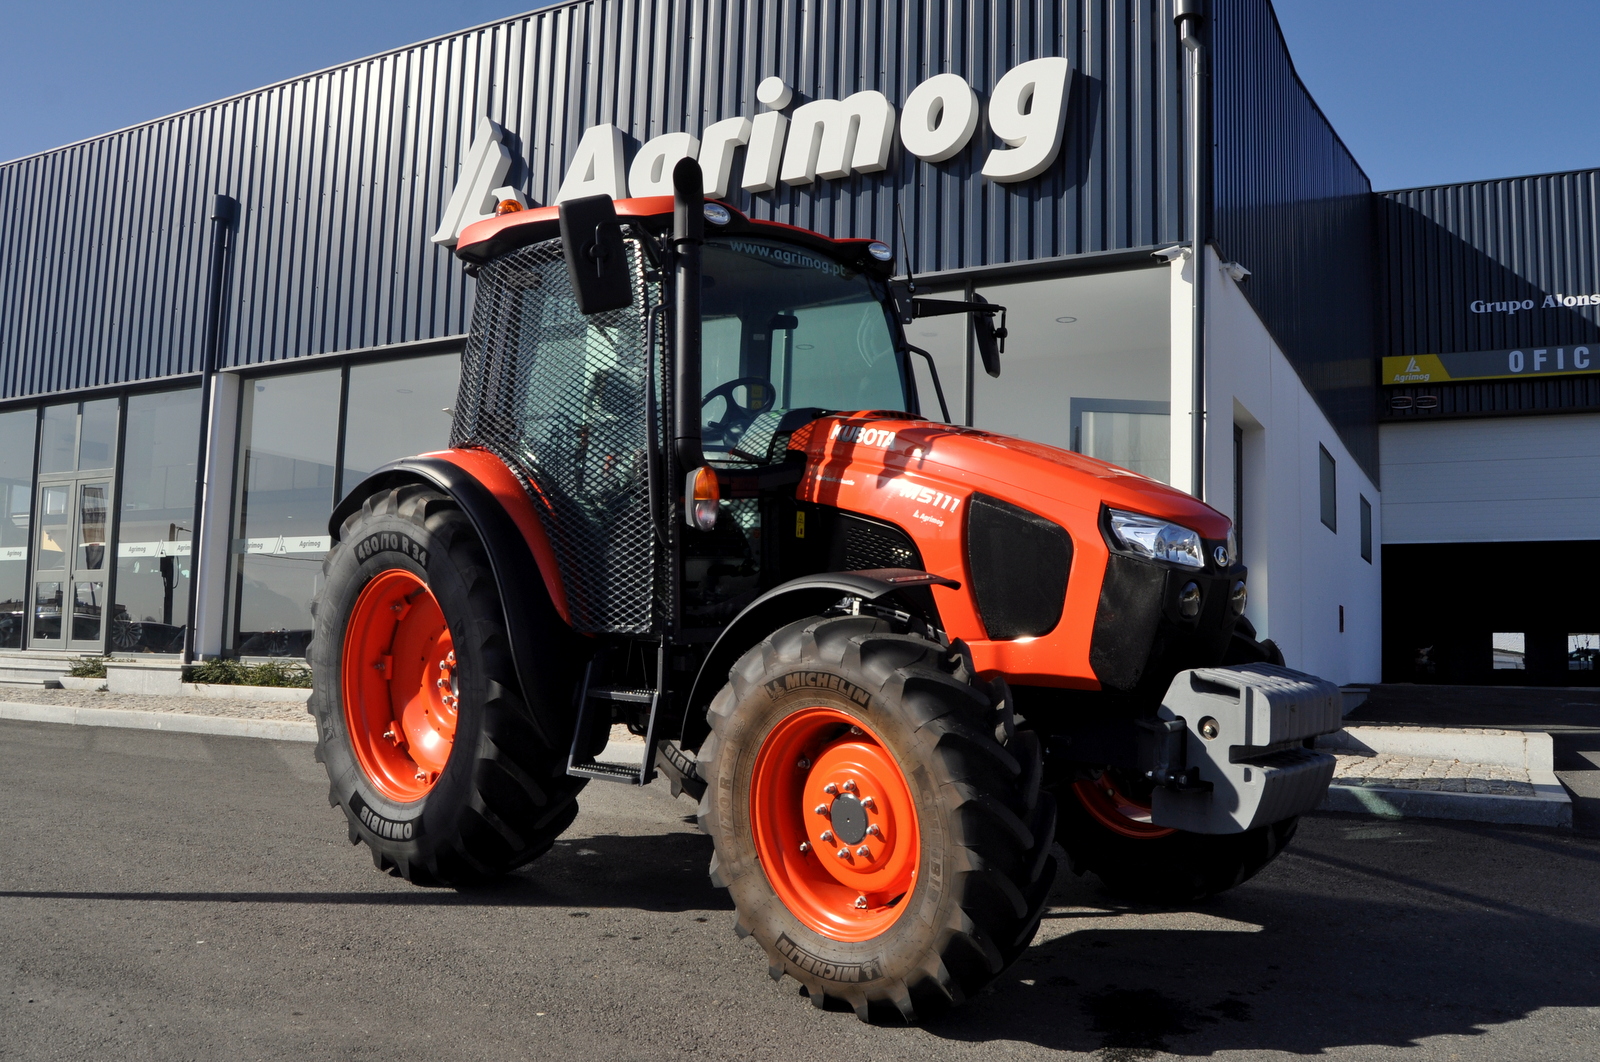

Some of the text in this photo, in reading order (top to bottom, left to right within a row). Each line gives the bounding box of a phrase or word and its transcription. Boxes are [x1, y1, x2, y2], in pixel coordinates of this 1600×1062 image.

[729, 240, 846, 277] www.agrimog.pt
[1470, 300, 1535, 315] Grupo
[1508, 346, 1600, 373] OFIC
[1393, 373, 1430, 383] Agrimog
[830, 424, 896, 450] KUBOTA
[920, 513, 945, 527] Agrimog
[128, 545, 146, 553] Agrimog
[299, 540, 321, 549] Agrimog
[358, 533, 427, 567] 480/70 R 34
[784, 672, 871, 706] MICHELIN
[360, 806, 413, 839] OMNIBIB
[775, 938, 861, 982] MICHELIN
